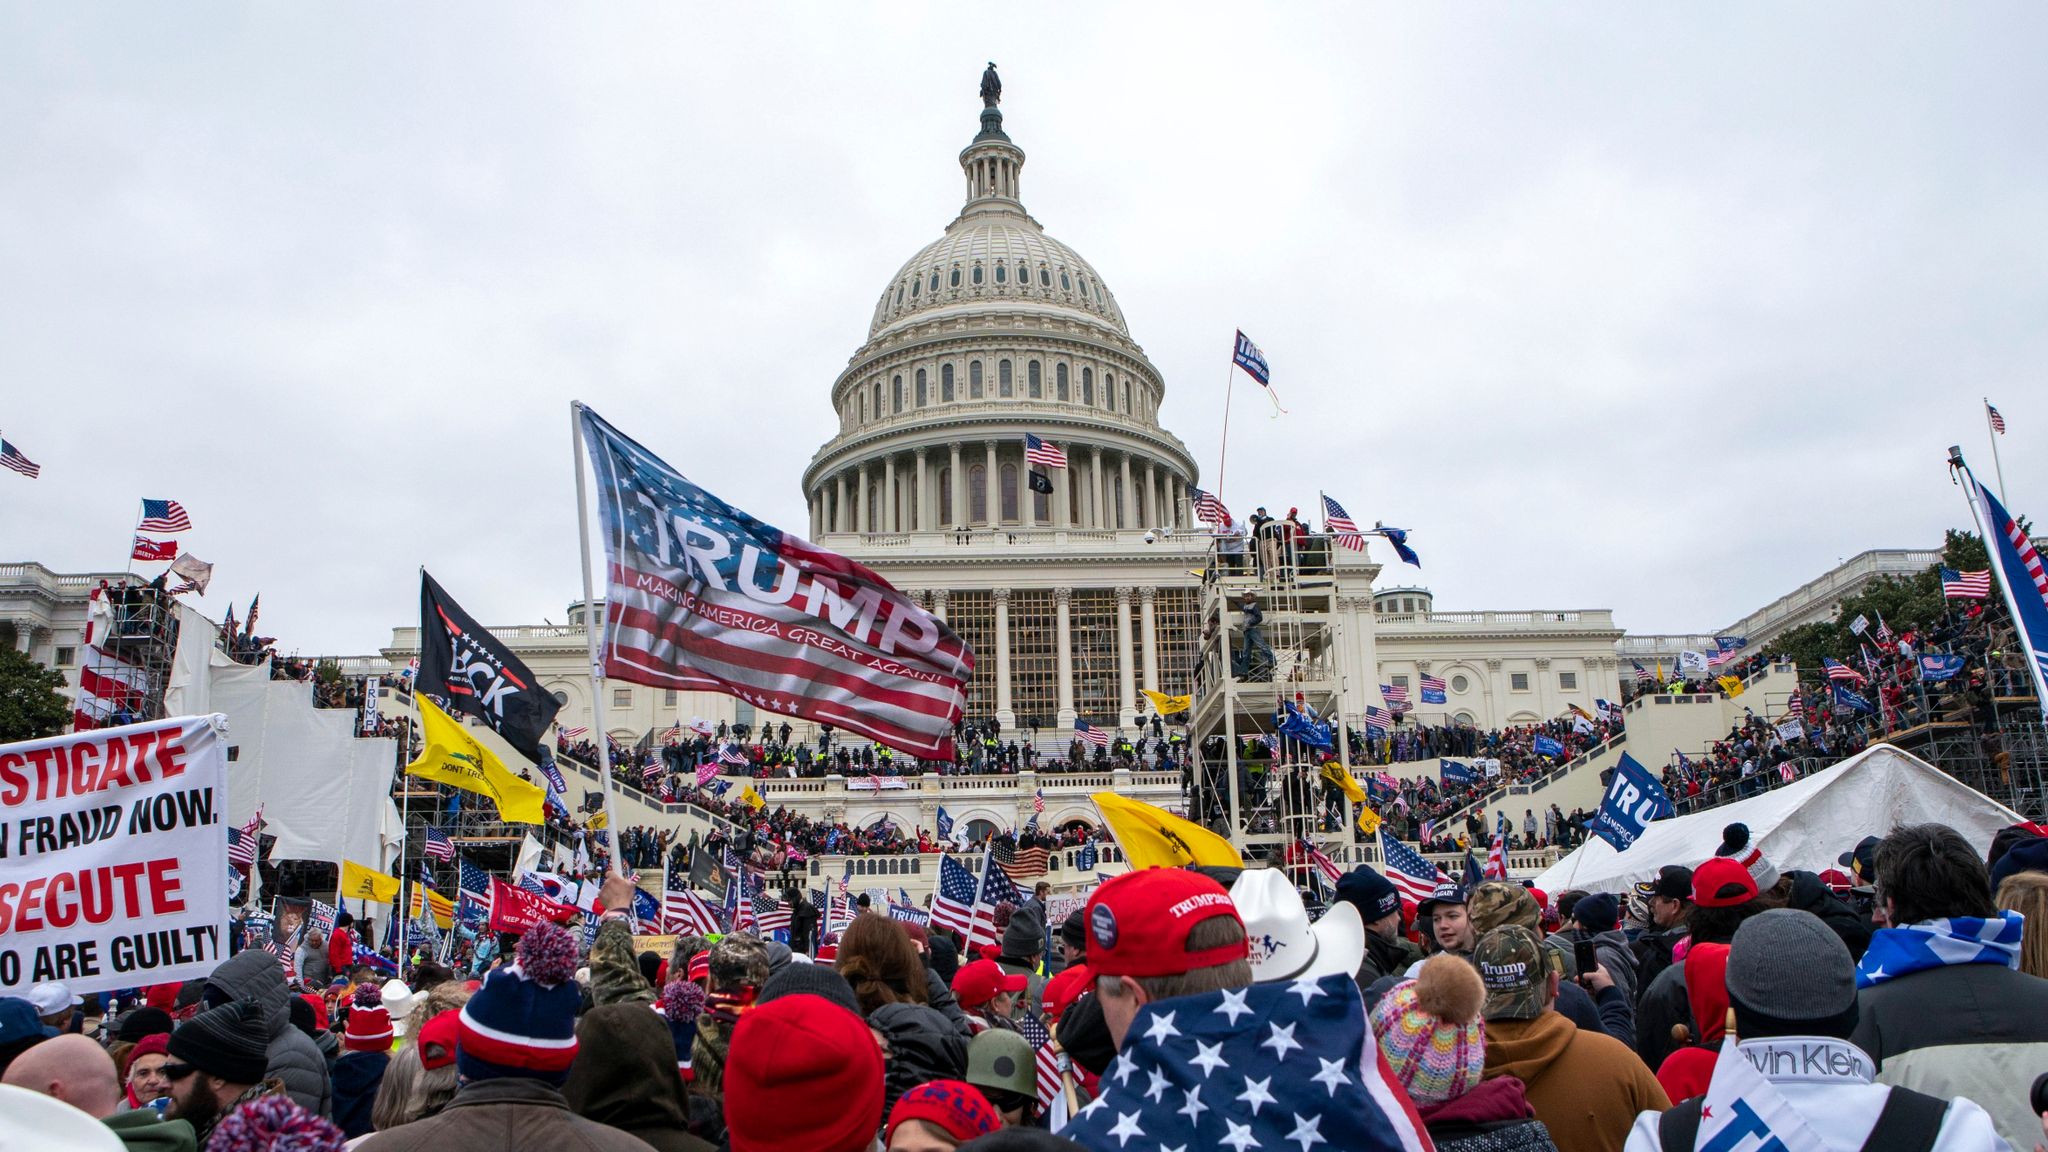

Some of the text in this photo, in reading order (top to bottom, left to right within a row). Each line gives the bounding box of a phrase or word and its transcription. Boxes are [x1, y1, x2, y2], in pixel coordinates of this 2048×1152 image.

[637, 491, 940, 655] TRUMP
[637, 574, 941, 683] MAKING AMERICA GREAT AGAIN!
[365, 678, 377, 730] TRUMP
[441, 761, 464, 775] DONT
[547, 762, 565, 793] TRUMP
[1443, 772, 1469, 783] LIBERTY
[20, 805, 123, 857] FRAUD
[128, 787, 218, 836] NOW.
[502, 882, 563, 916] TRUM
[502, 915, 520, 923] KEEP
[891, 908, 928, 926] TRUMP
[32, 941, 100, 983] ARE
[110, 924, 218, 973] GUILTY
[1481, 961, 1526, 976] Trump
[1802, 1044, 1862, 1077] Klein
